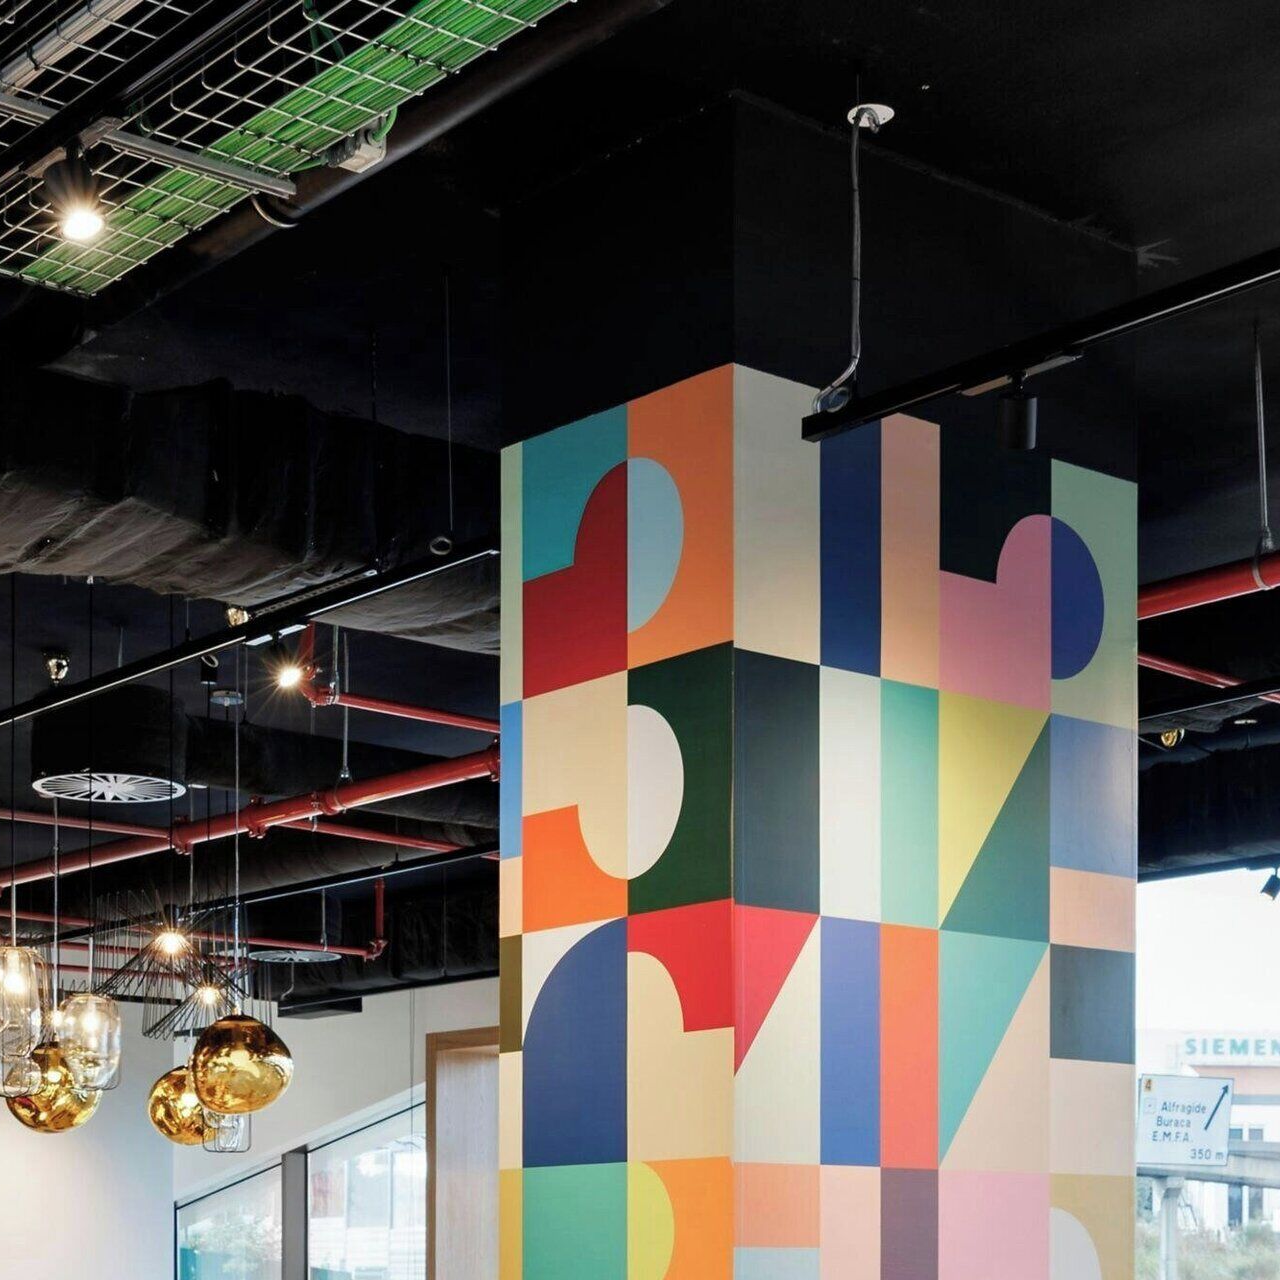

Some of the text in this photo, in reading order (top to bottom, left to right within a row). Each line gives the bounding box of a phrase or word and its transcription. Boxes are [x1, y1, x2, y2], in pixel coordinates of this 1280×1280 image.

[1161, 1101, 1207, 1115] Alfragide
[1156, 1115, 1191, 1128] Buraca
[1190, 1148, 1212, 1160] 350
